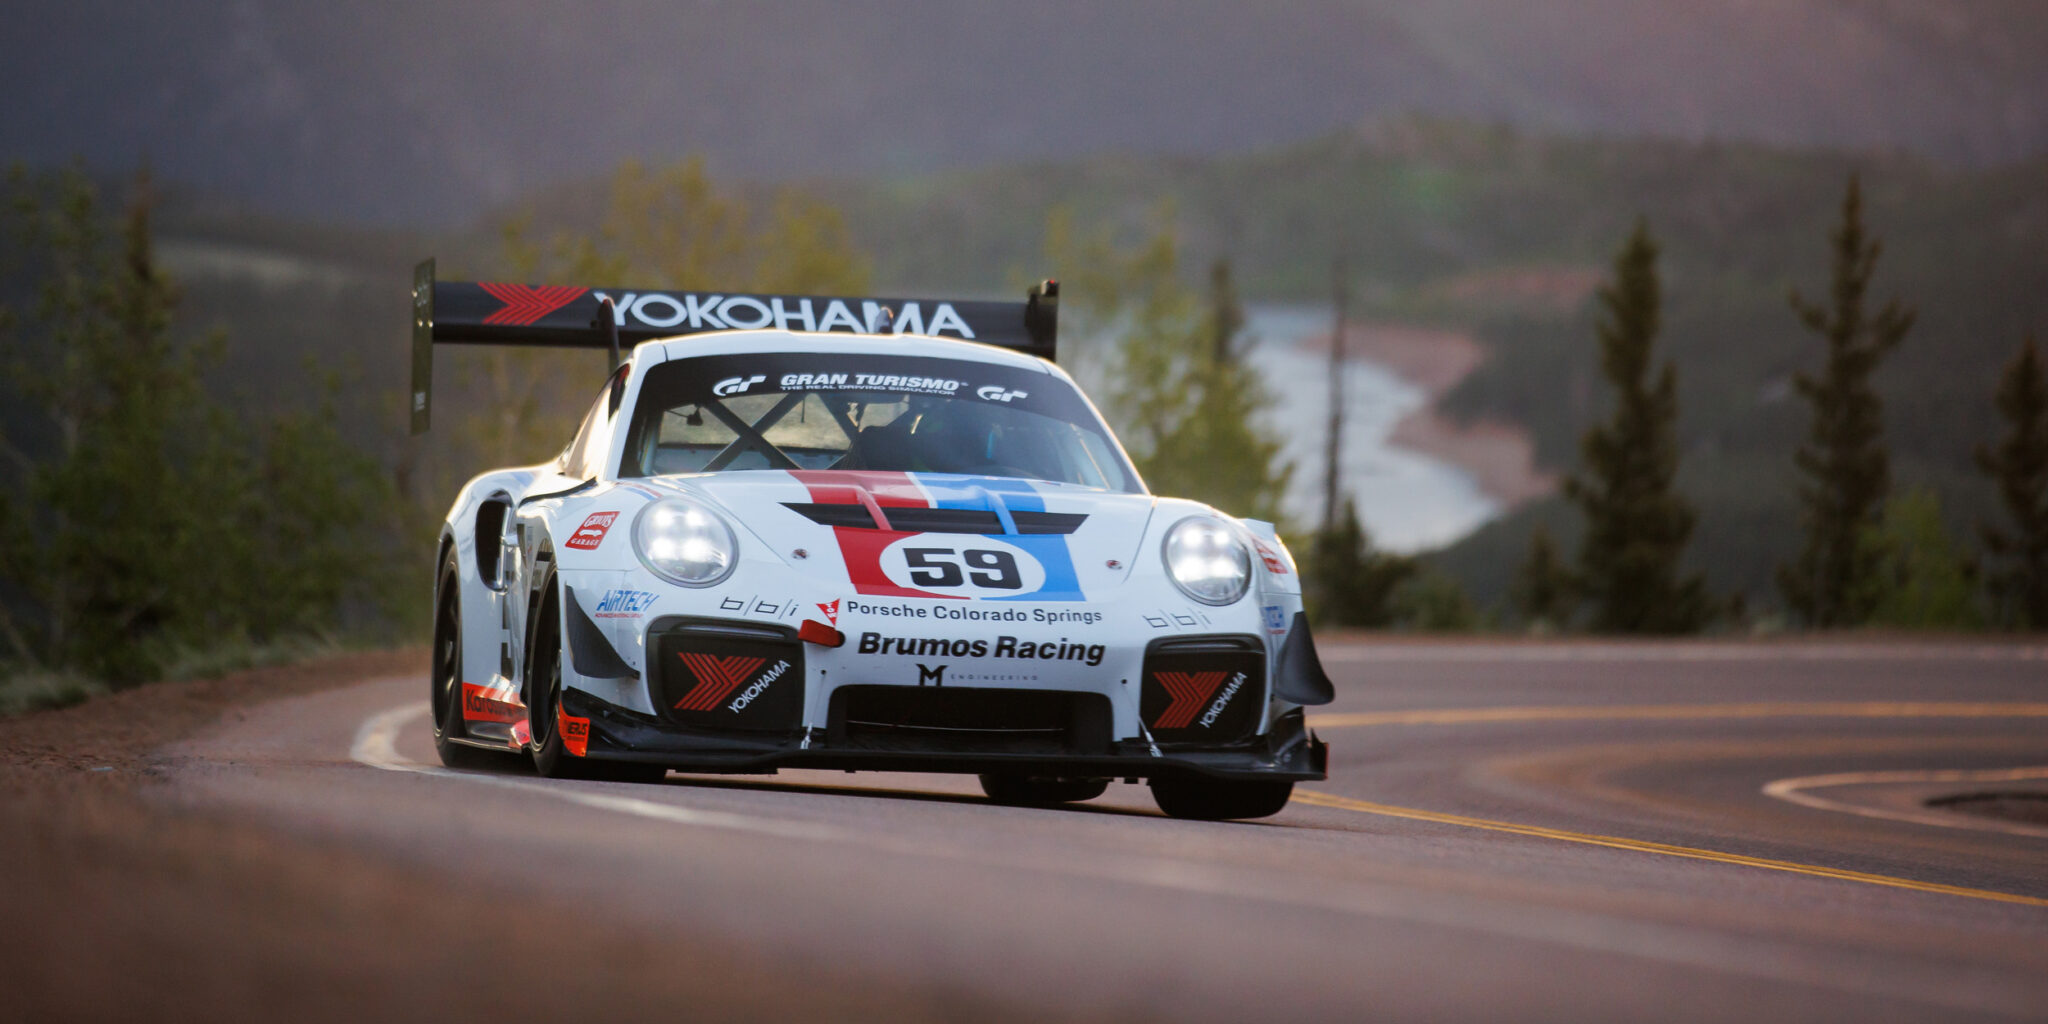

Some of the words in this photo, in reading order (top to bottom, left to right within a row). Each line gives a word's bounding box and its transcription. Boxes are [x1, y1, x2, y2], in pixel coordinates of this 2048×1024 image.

[594, 291, 975, 338] YOKOHAMA
[781, 374, 848, 386] GRAN
[855, 374, 960, 391] TURISMO
[888, 386, 956, 396] SIMULATOR
[571, 538, 600, 546] GARAGE
[902, 547, 1023, 590] 59
[847, 601, 927, 618] Porsche
[934, 605, 1028, 621] Colorado
[1033, 608, 1103, 625] Springs
[858, 631, 988, 658] Brumos
[994, 635, 1107, 667] Racing
[728, 659, 792, 714] YOKOHAMA
[1199, 671, 1248, 728] YOKOHAMA
